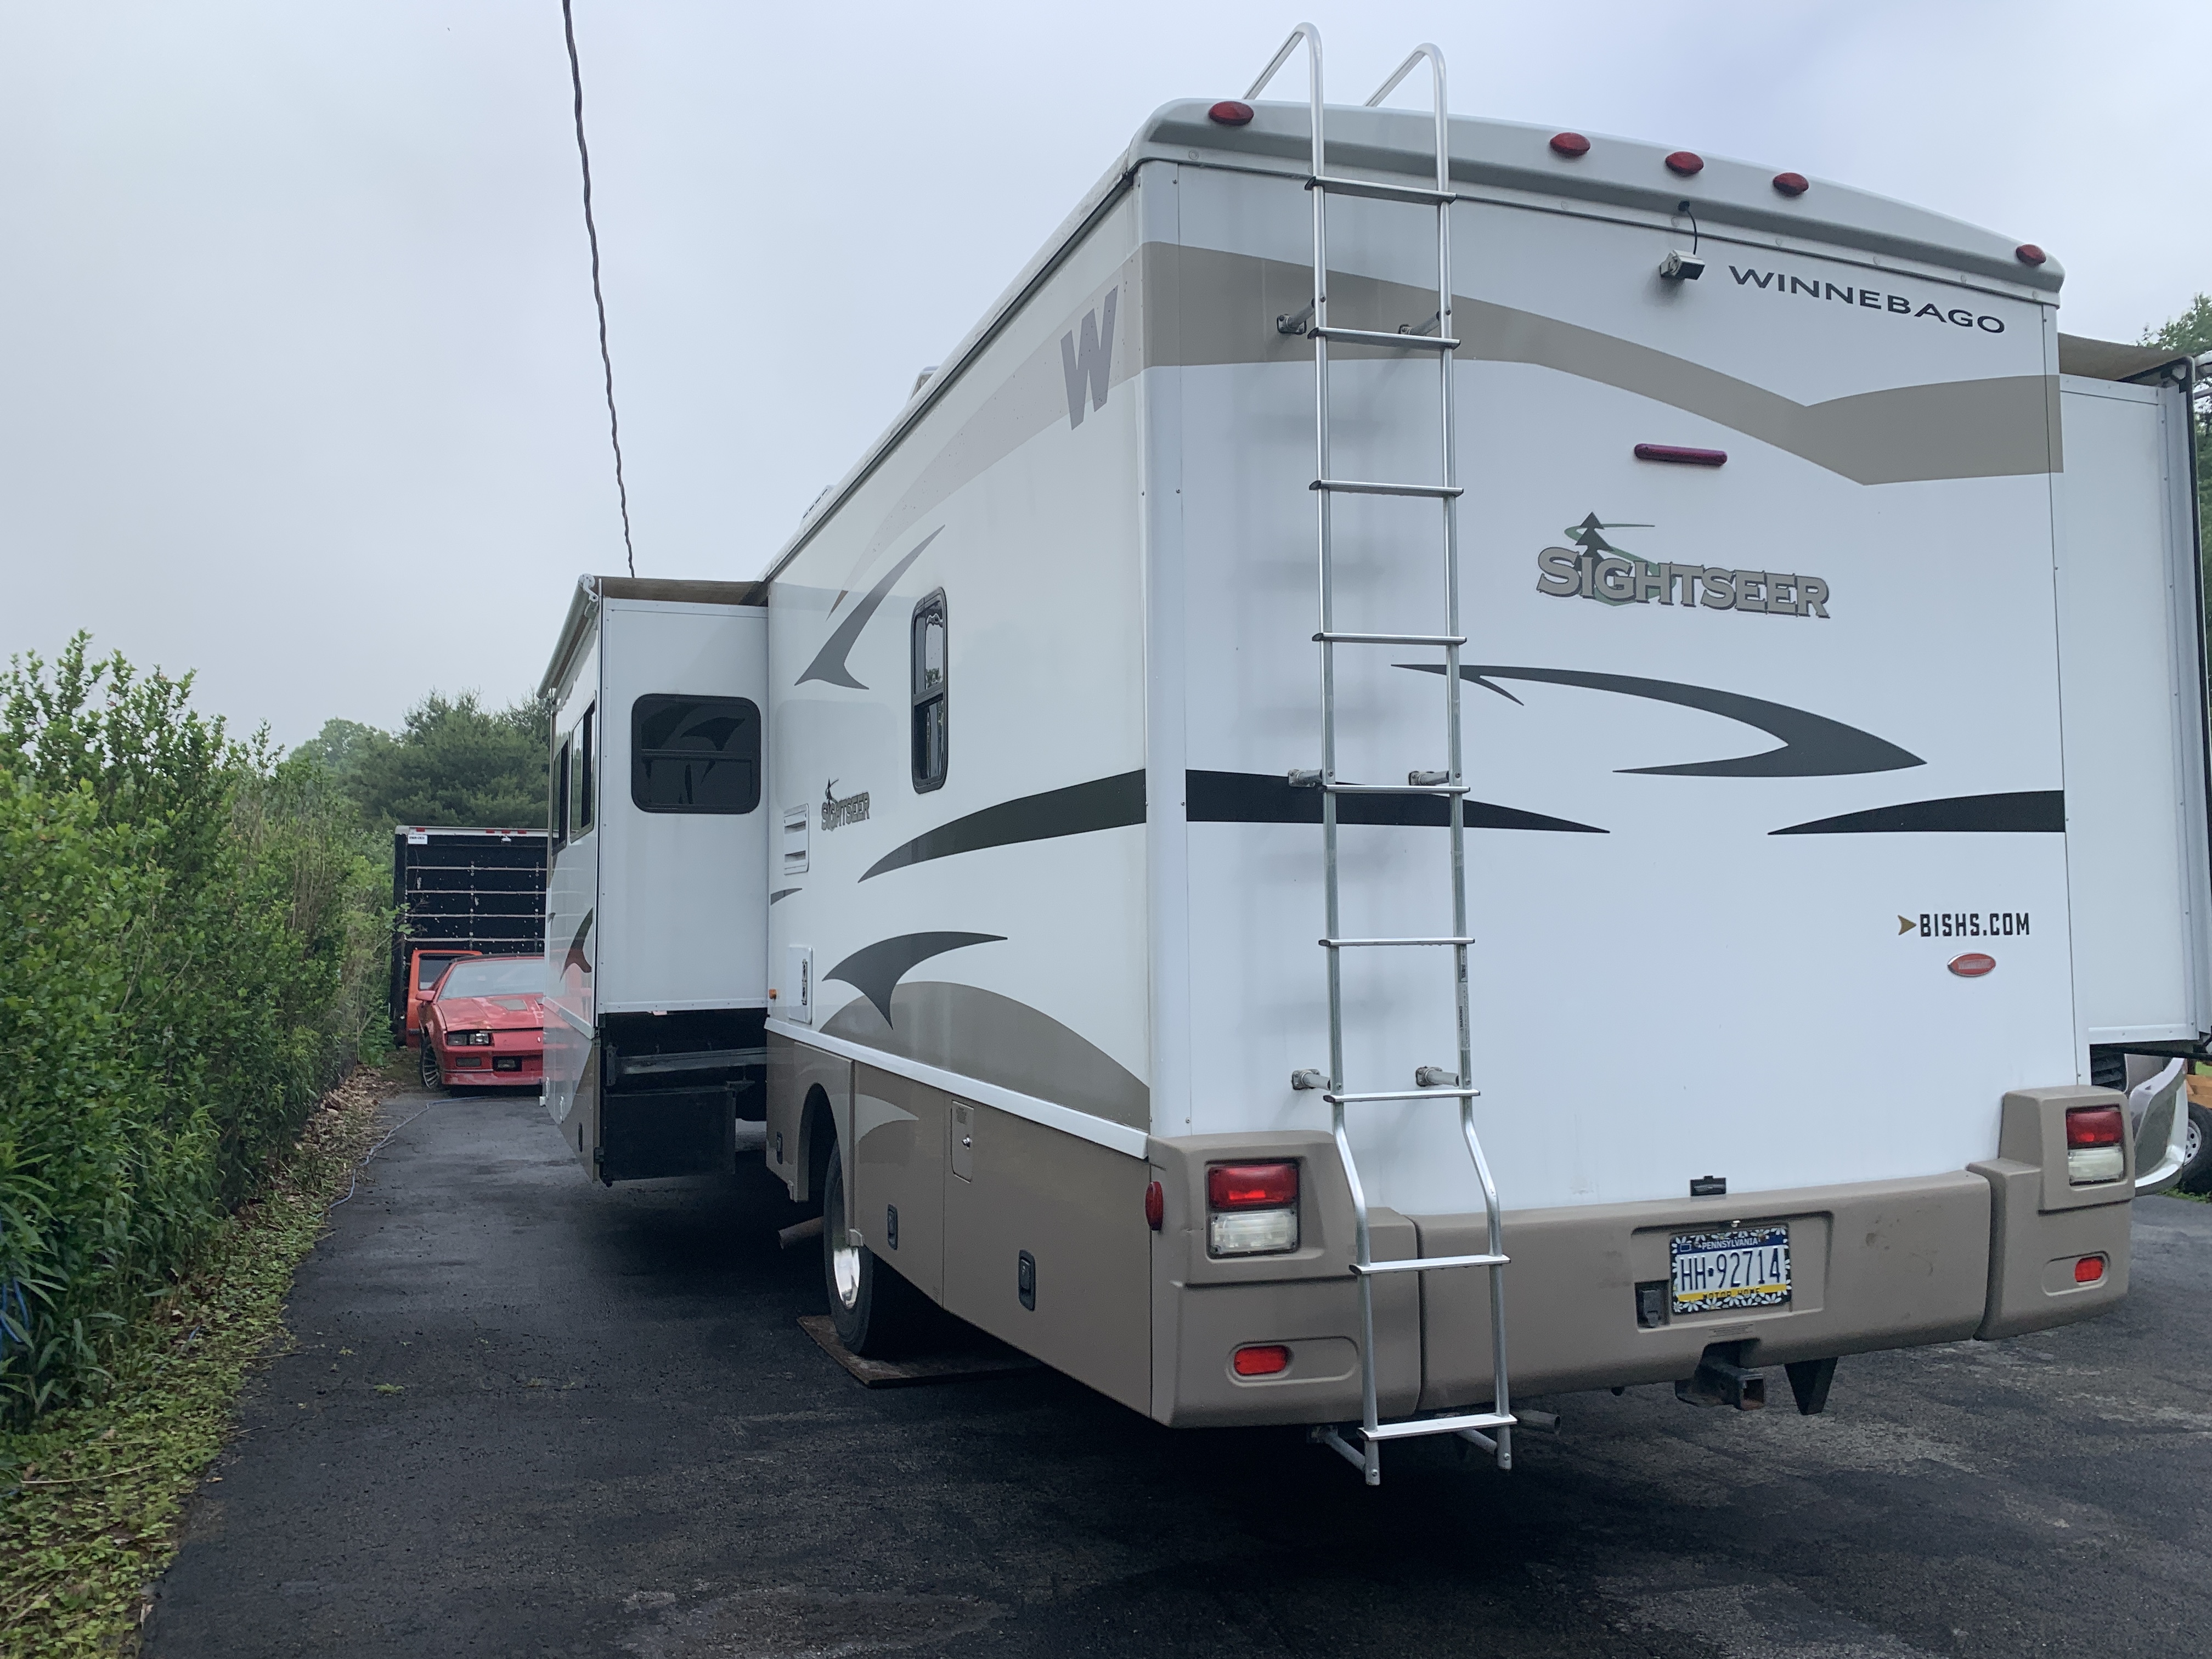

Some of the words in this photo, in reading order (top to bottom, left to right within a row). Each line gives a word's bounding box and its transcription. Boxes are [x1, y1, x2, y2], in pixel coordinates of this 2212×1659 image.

[1728, 264, 2006, 334] WINNEBAGO
[1060, 284, 1119, 431] W
[1536, 545, 1831, 619] SIGHTSEER
[821, 791, 871, 831] SIGHTSEER
[1920, 912, 2030, 937] BISHS.COM
[1702, 1237, 1758, 1250] PENNSYLVANIA
